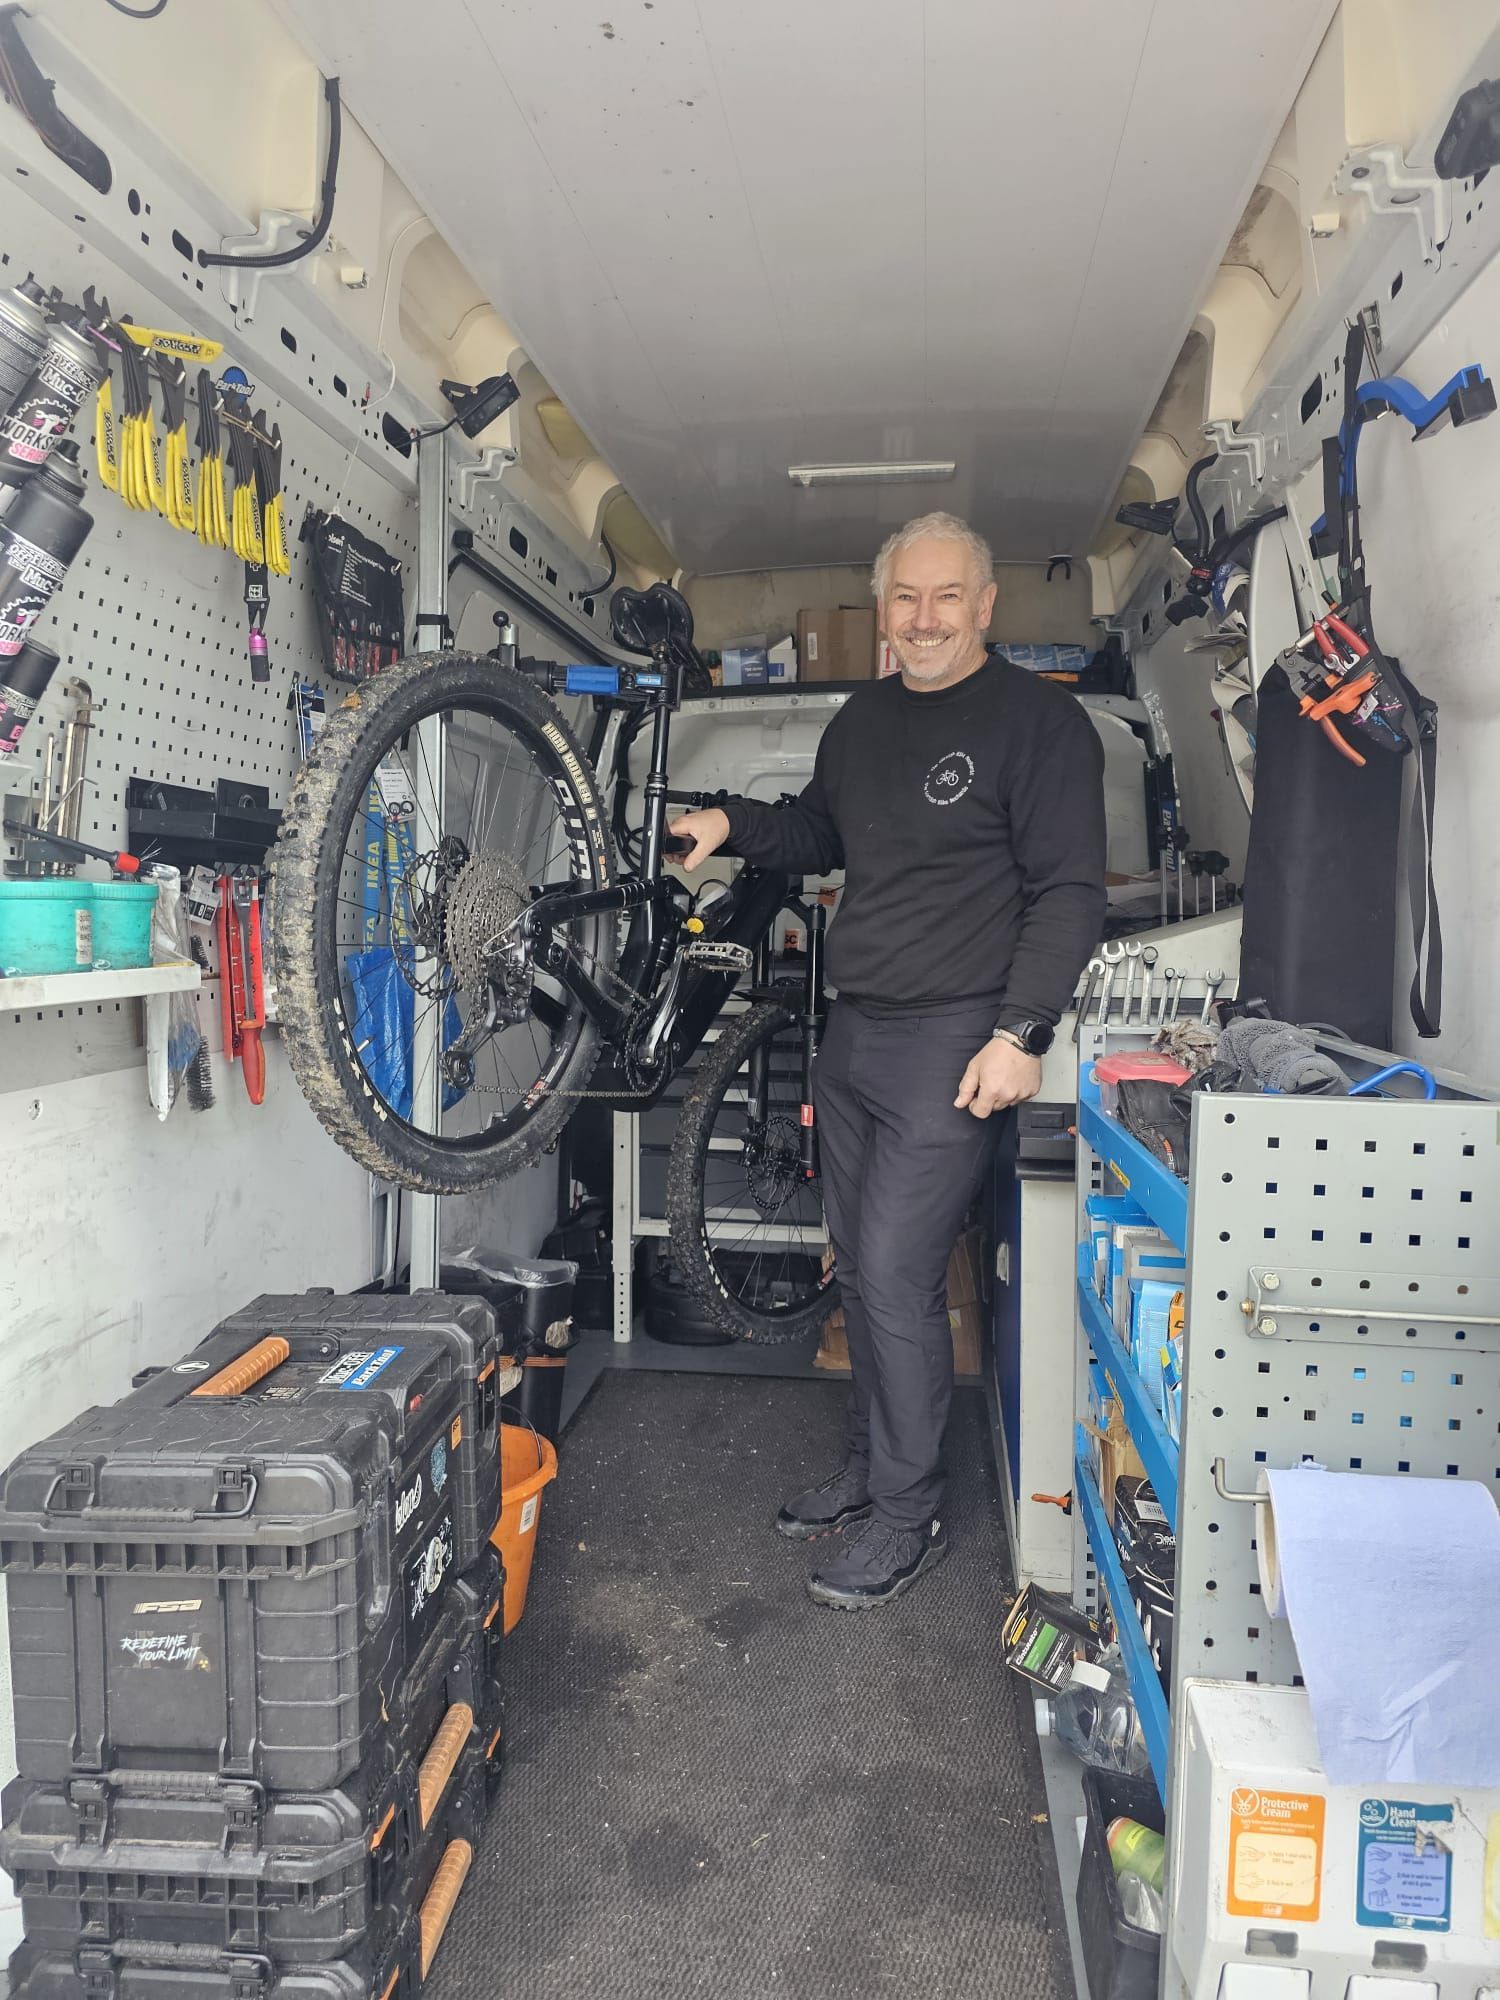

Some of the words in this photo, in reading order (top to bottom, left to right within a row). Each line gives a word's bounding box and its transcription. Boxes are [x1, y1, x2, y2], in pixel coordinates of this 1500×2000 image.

[120, 1634, 188, 1650] REDEFINE
[139, 1650, 166, 1663] YOUR
[167, 1646, 202, 1662] LIMIT
[1261, 1797, 1309, 1811] Protective
[1261, 1807, 1291, 1818] Cream
[1390, 1807, 1416, 1819] Hand
